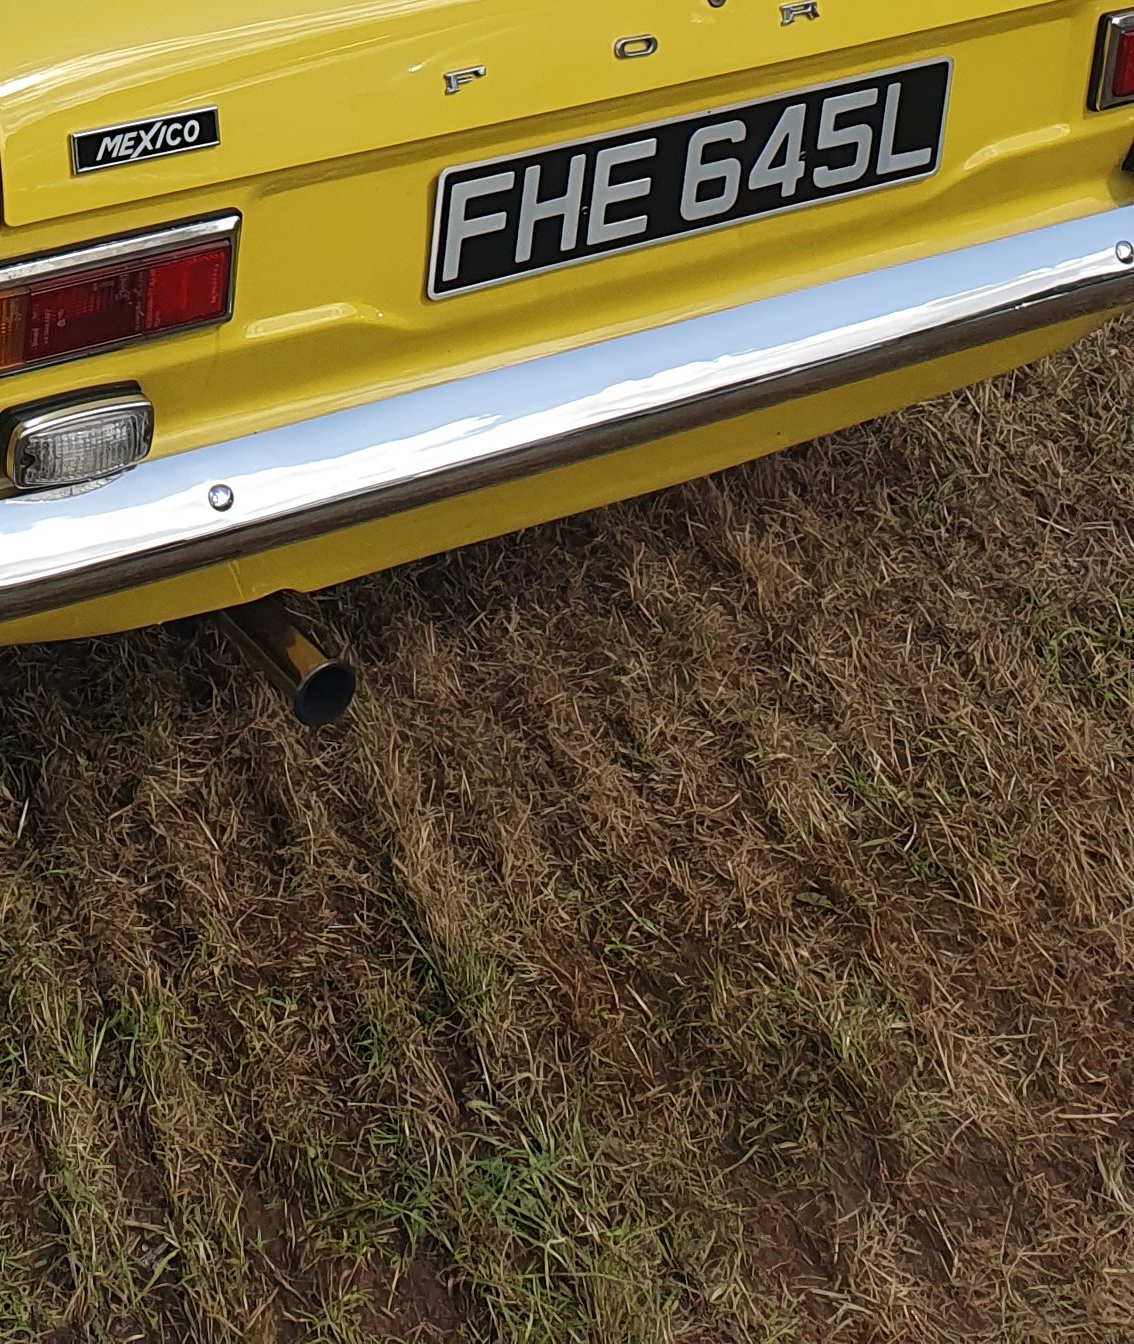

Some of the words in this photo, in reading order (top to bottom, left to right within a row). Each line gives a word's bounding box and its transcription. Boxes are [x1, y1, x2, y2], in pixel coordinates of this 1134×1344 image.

[95, 119, 200, 162] MEXICO
[442, 137, 657, 282] FHE
[679, 82, 933, 222] 645L
